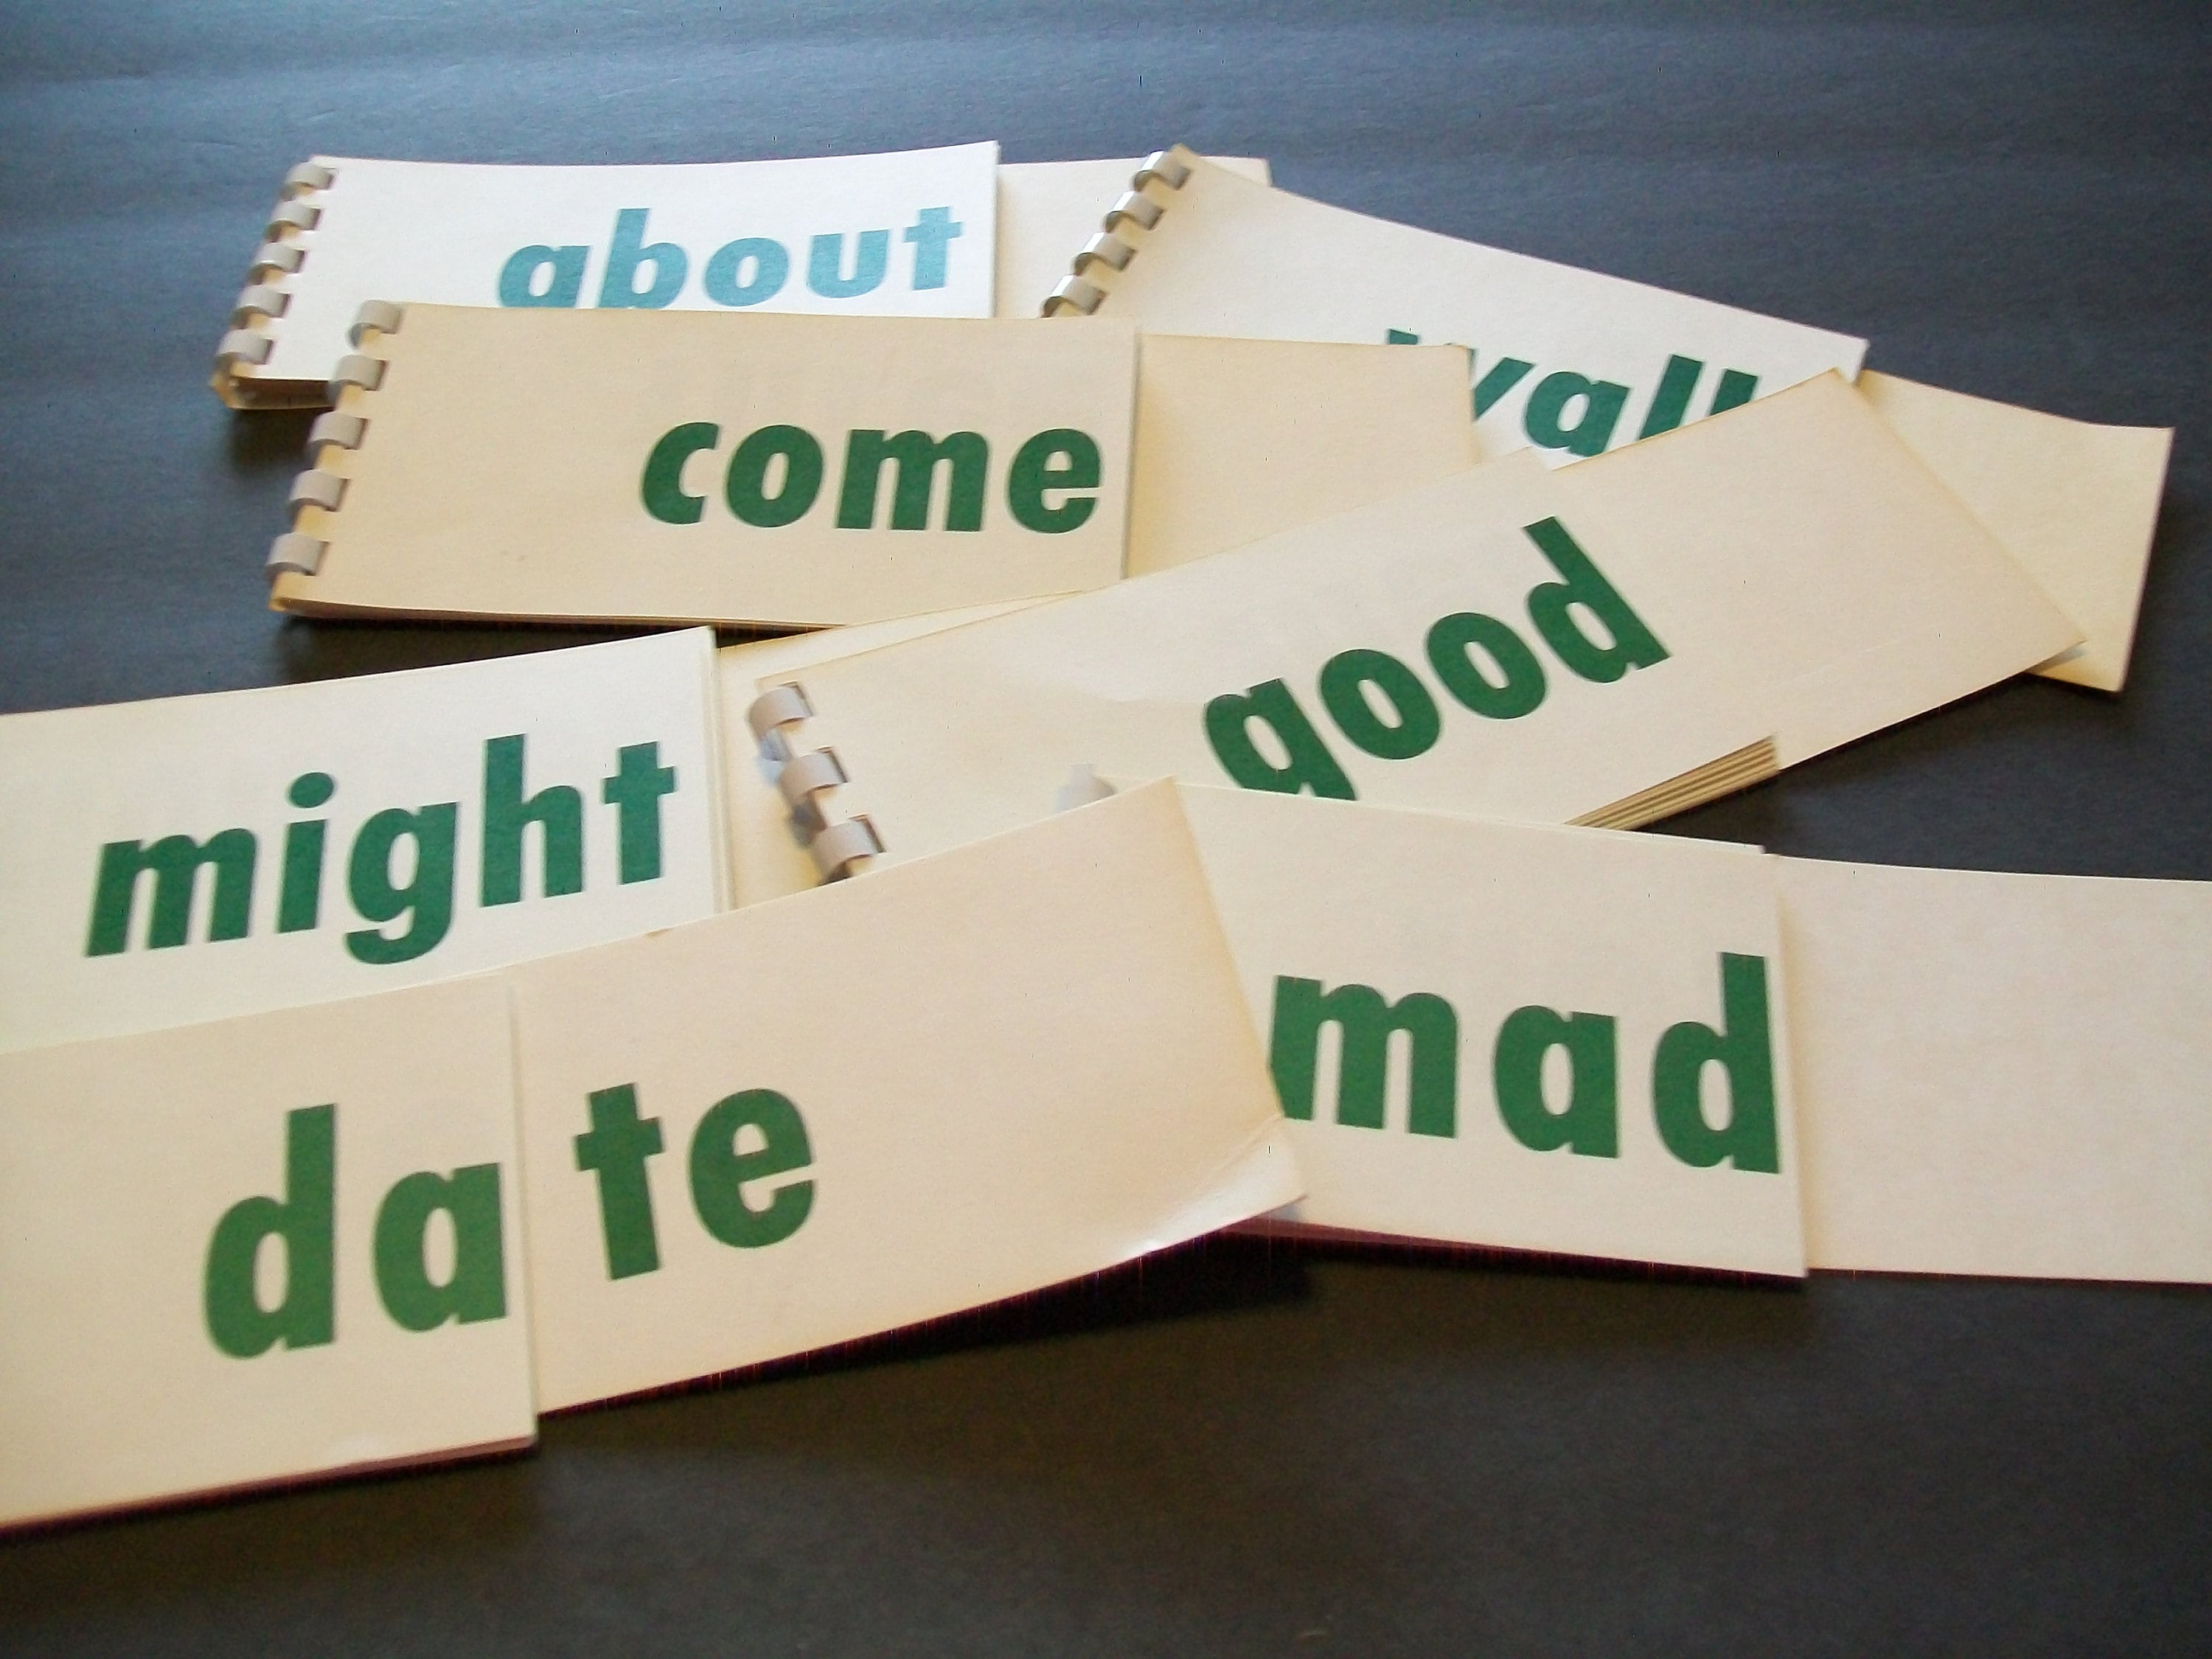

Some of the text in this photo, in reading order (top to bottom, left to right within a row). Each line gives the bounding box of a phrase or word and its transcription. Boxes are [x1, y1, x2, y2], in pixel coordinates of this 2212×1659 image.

[495, 206, 964, 309] about
[643, 422, 1100, 532] come
[1205, 517, 1667, 799] good
[86, 734, 678, 966] might
[1271, 952, 1781, 1174] mad
